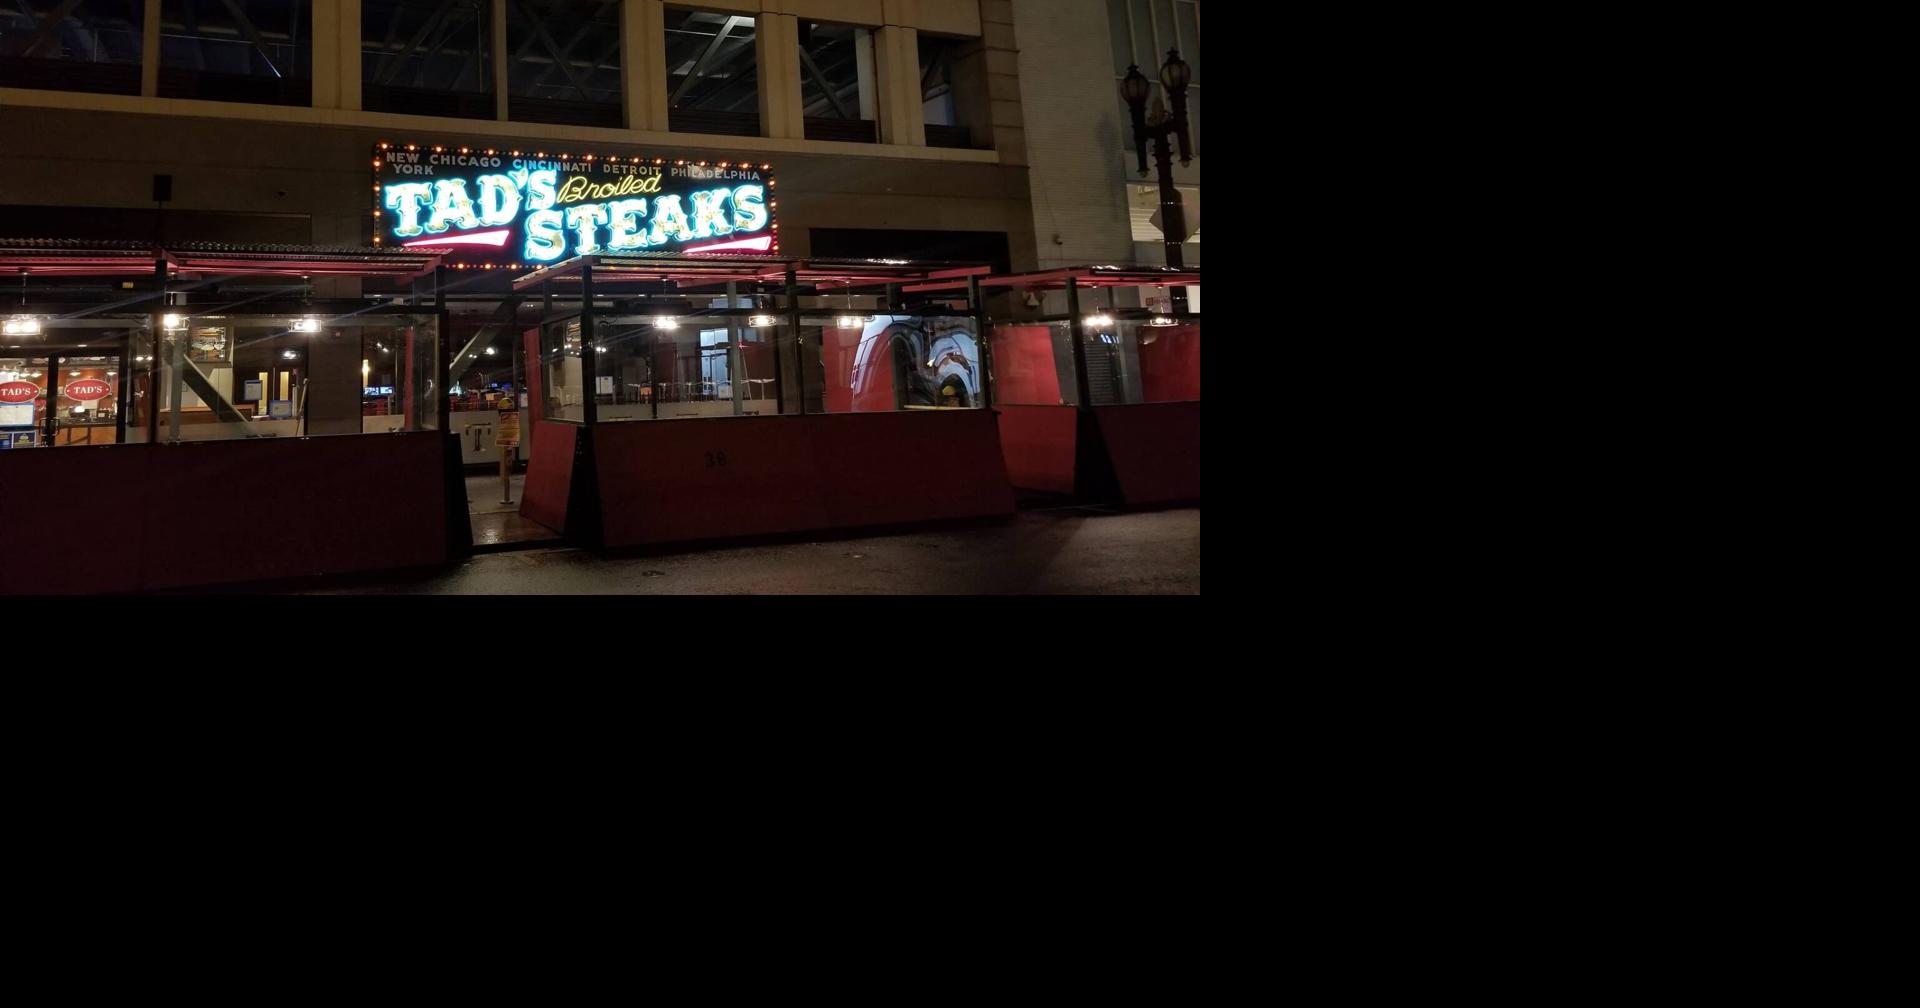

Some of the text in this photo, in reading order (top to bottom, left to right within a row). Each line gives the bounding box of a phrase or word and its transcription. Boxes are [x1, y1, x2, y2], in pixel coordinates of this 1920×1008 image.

[386, 152, 761, 181] NEW CHICAGO CINCINNATI DETROIT PHILADELPHIA
[393, 163, 434, 176] YORK
[384, 168, 558, 237] TAD'S
[556, 173, 662, 204] Broiled
[524, 184, 769, 261] STEAKS
[1, 387, 31, 396] TAD'S
[73, 385, 103, 394] TAD'S
